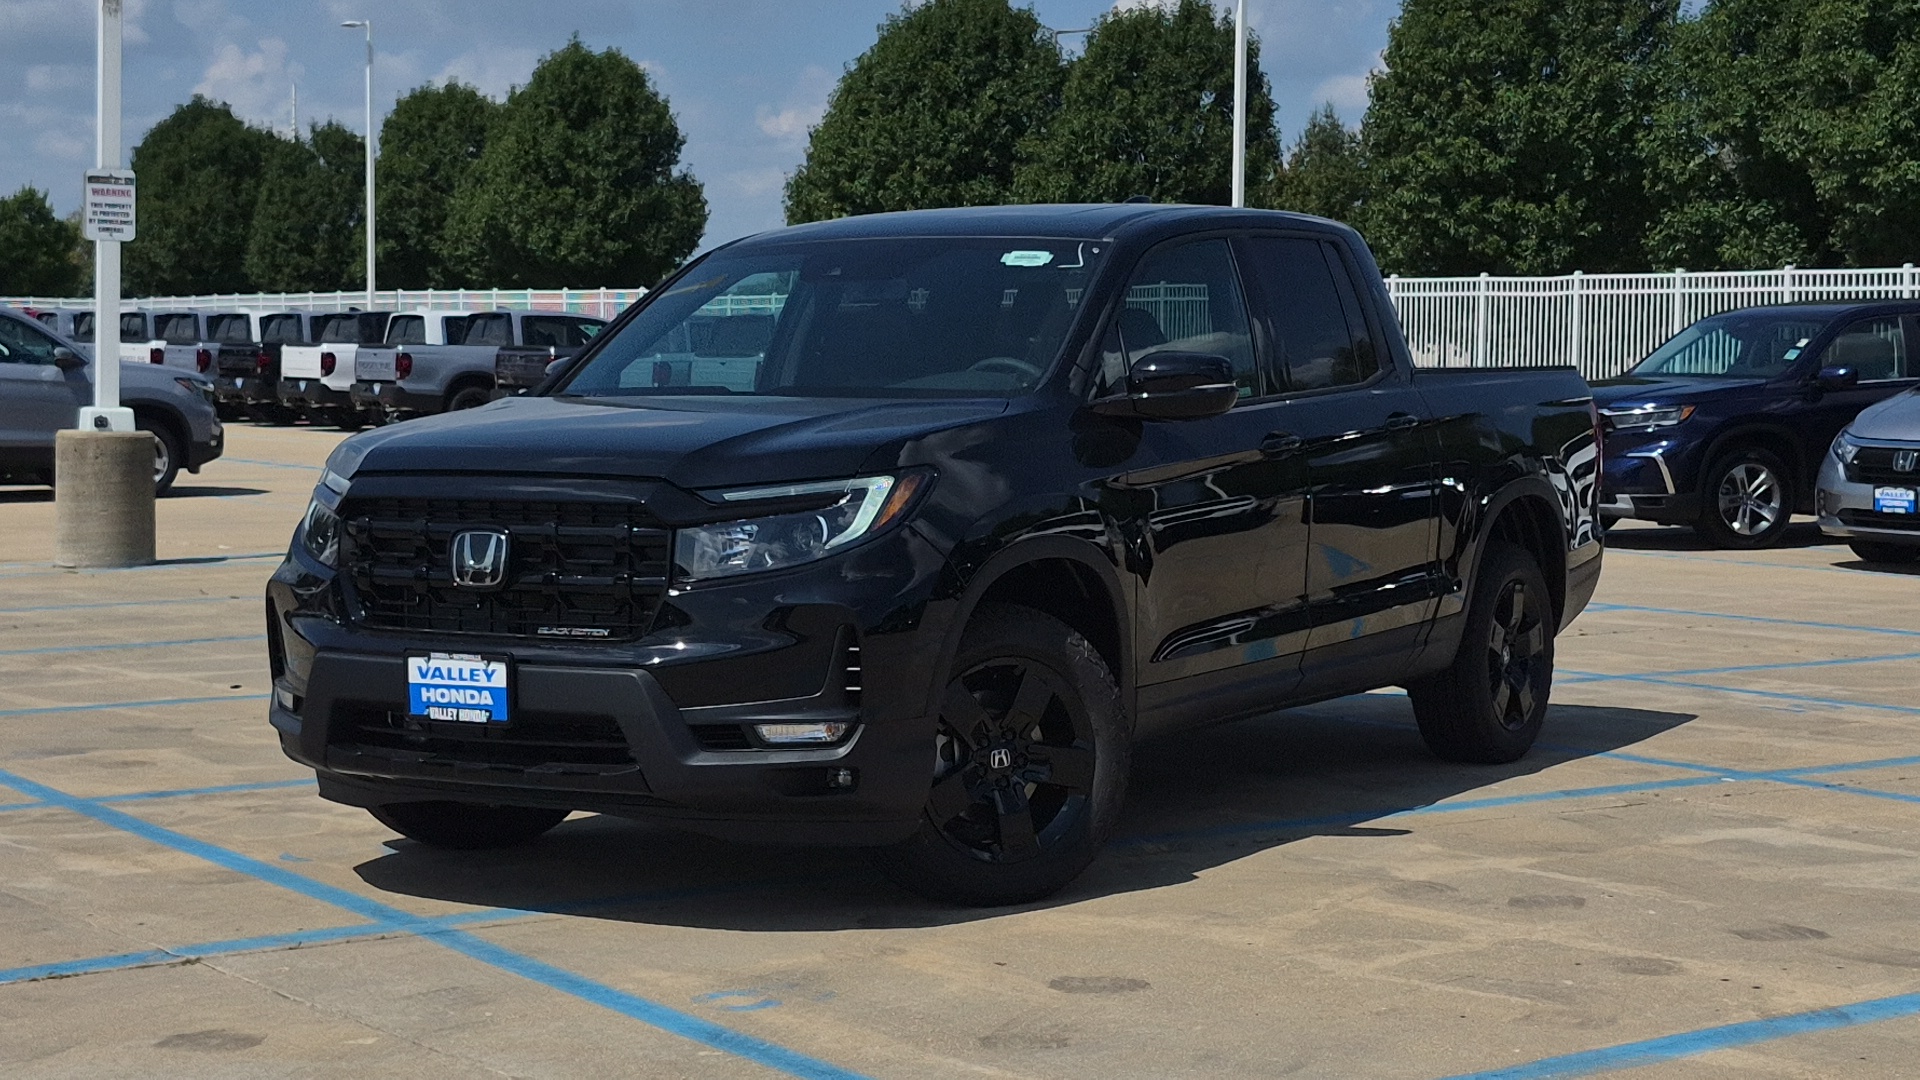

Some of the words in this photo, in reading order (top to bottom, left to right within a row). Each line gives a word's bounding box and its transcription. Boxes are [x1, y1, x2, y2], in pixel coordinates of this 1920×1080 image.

[91, 188, 132, 197] WARNING
[1879, 490, 1910, 498] VALLEY
[417, 666, 497, 682] VALLEY
[421, 687, 494, 705] HONDA
[429, 706, 457, 720] VALLEY
[459, 708, 487, 722] HONDA
